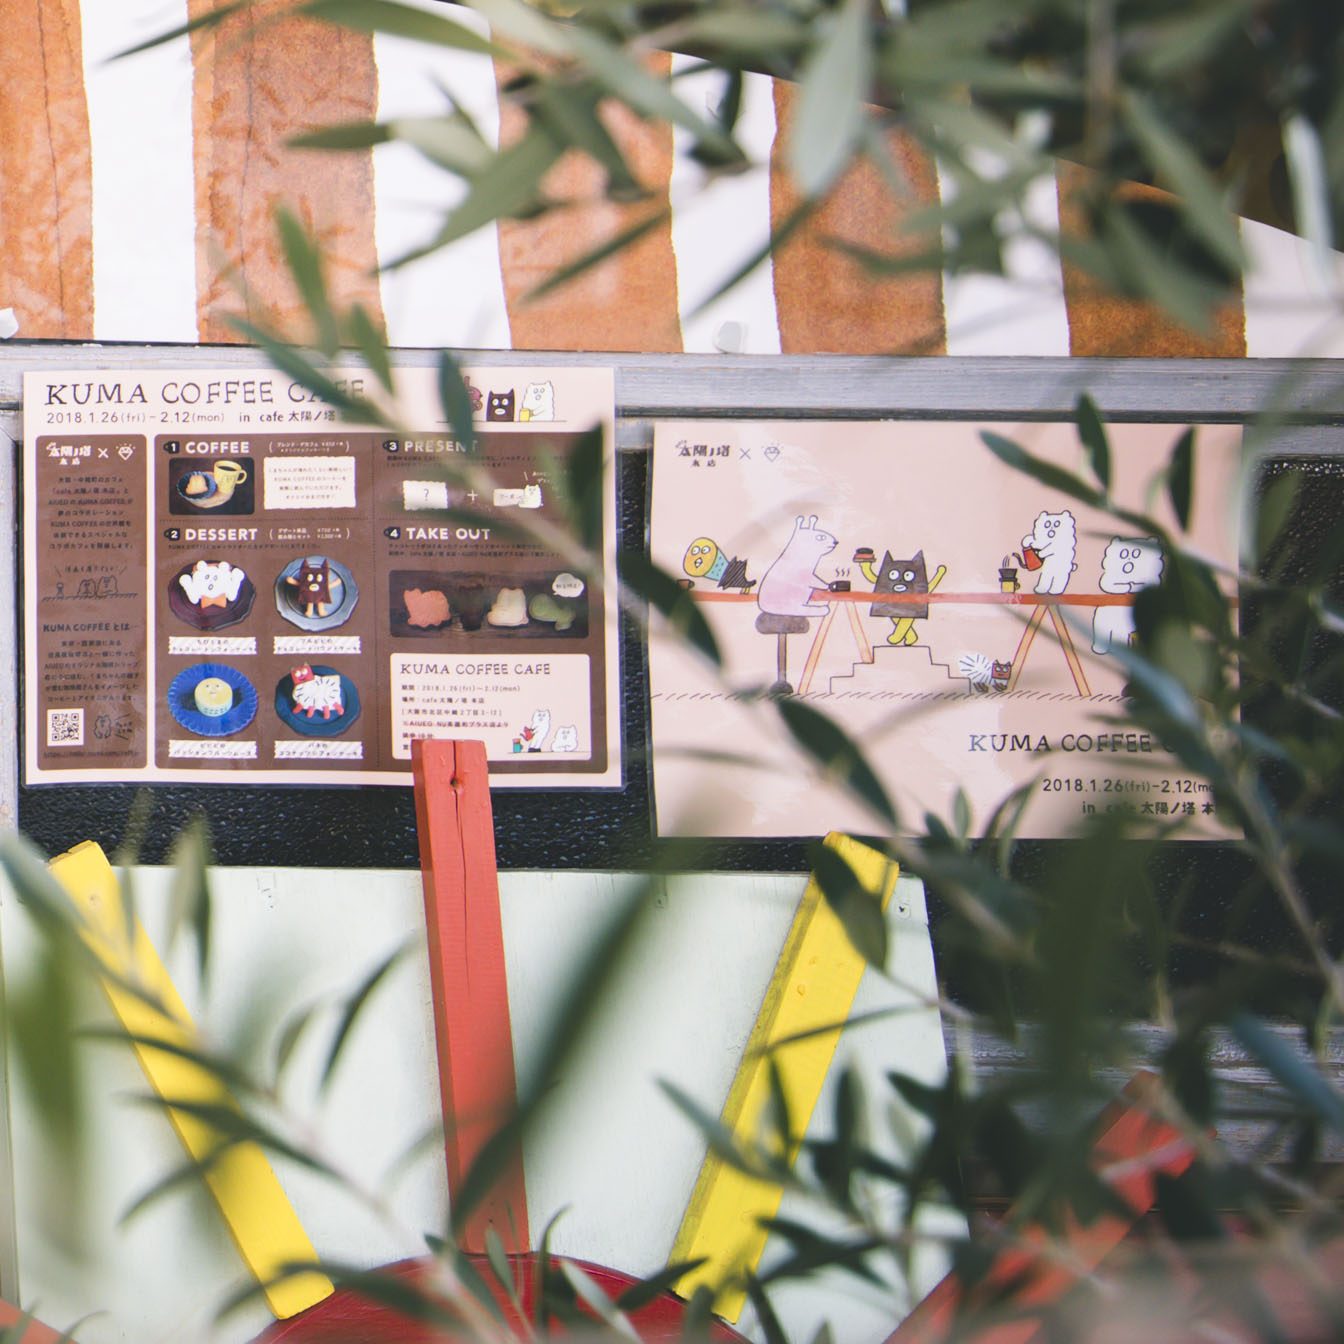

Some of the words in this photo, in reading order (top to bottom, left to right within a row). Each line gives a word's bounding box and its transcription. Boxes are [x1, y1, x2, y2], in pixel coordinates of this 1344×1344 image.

[44, 383, 148, 406] KUMA
[161, 380, 274, 405] COFFEE
[239, 411, 250, 423] in
[259, 411, 285, 423] cafe
[185, 441, 250, 454] COFFEE
[389, 442, 397, 451] 3
[170, 530, 178, 539] 2
[185, 528, 258, 541] DESSERT
[389, 529, 398, 538] 4
[406, 528, 449, 540] TAKE
[456, 528, 491, 540] OUT
[43, 623, 72, 632] KUMA
[73, 622, 111, 632] COFFEE
[400, 663, 450, 675] KUMA
[456, 663, 509, 675] COFFEE
[514, 663, 551, 675] CAFE
[967, 734, 1052, 752] KUMA
[1061, 733, 1153, 753] COFFEE
[1082, 801, 1096, 814] in
[1140, 801, 1196, 816] 太陽ノ塔
